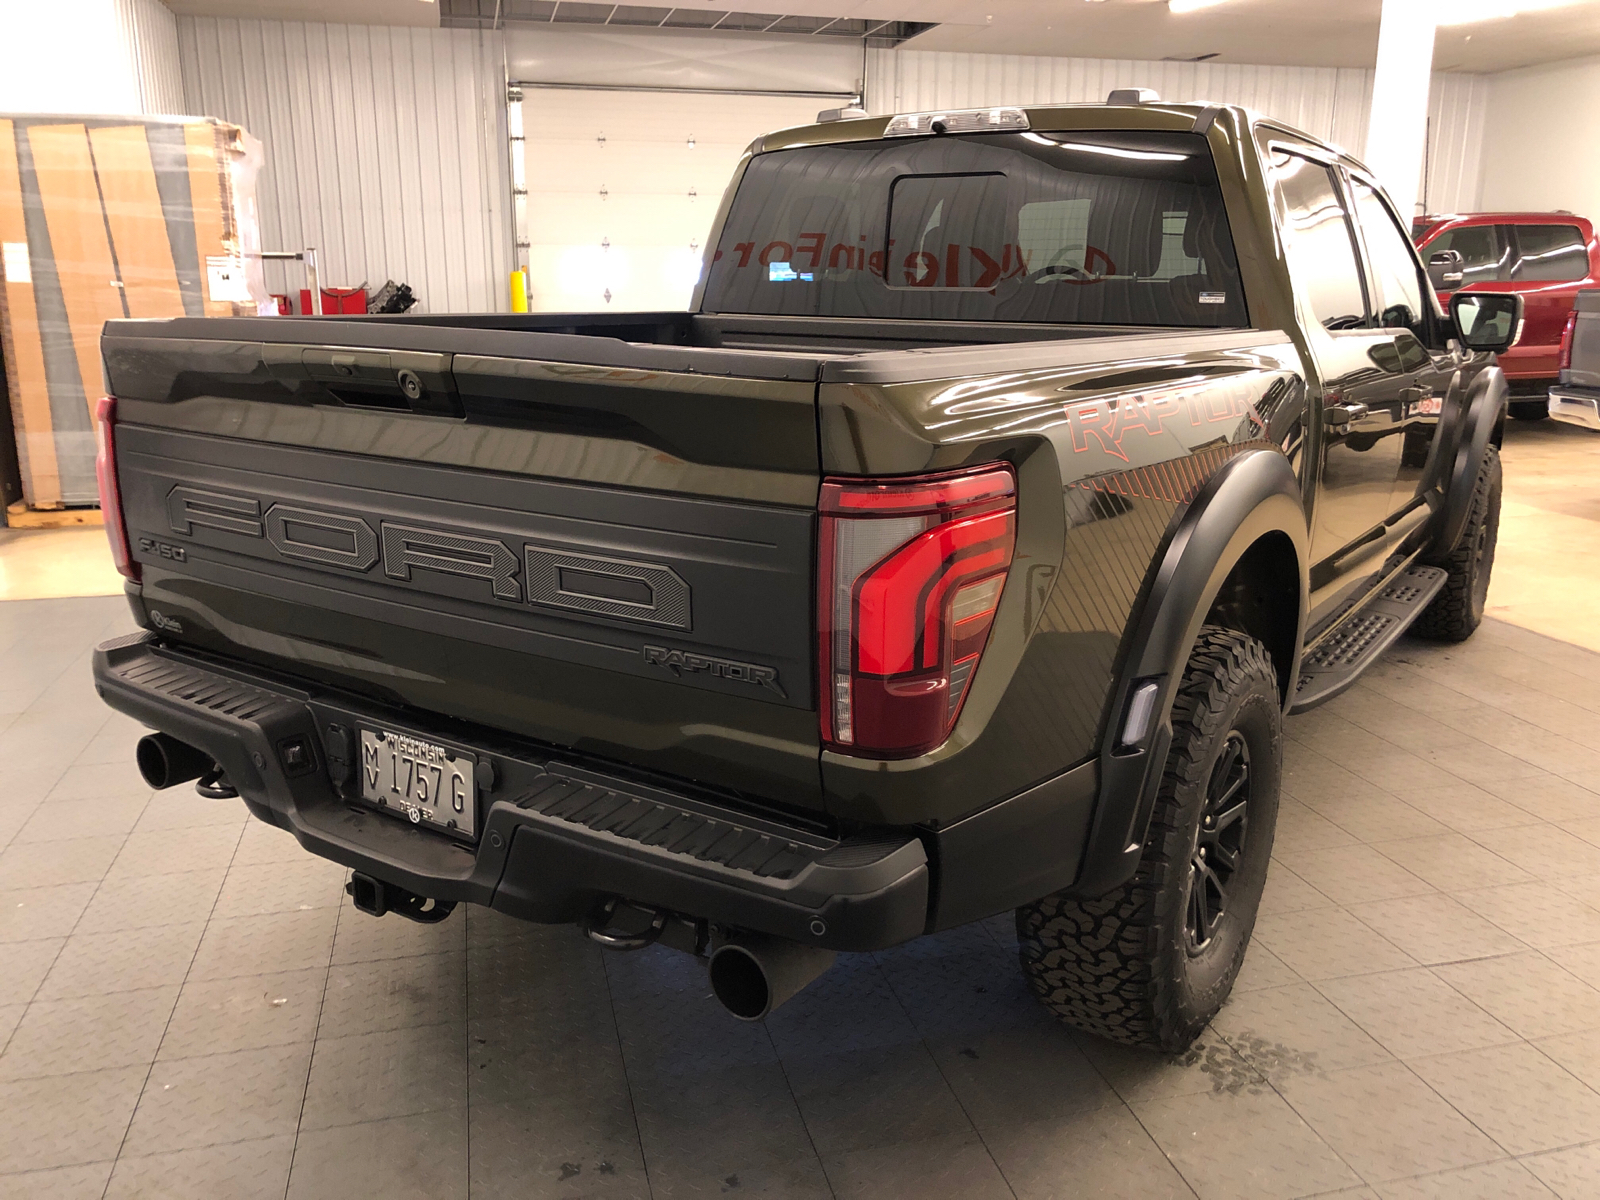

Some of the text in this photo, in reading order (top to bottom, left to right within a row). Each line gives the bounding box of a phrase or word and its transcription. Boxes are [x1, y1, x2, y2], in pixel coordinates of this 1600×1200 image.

[1064, 383, 1264, 463] RAPTOR
[166, 484, 692, 633] FORD
[643, 643, 789, 699] RAPTOR
[387, 737, 446, 765] WISCONSIN
[391, 751, 443, 807] 1757
[451, 771, 466, 814] G
